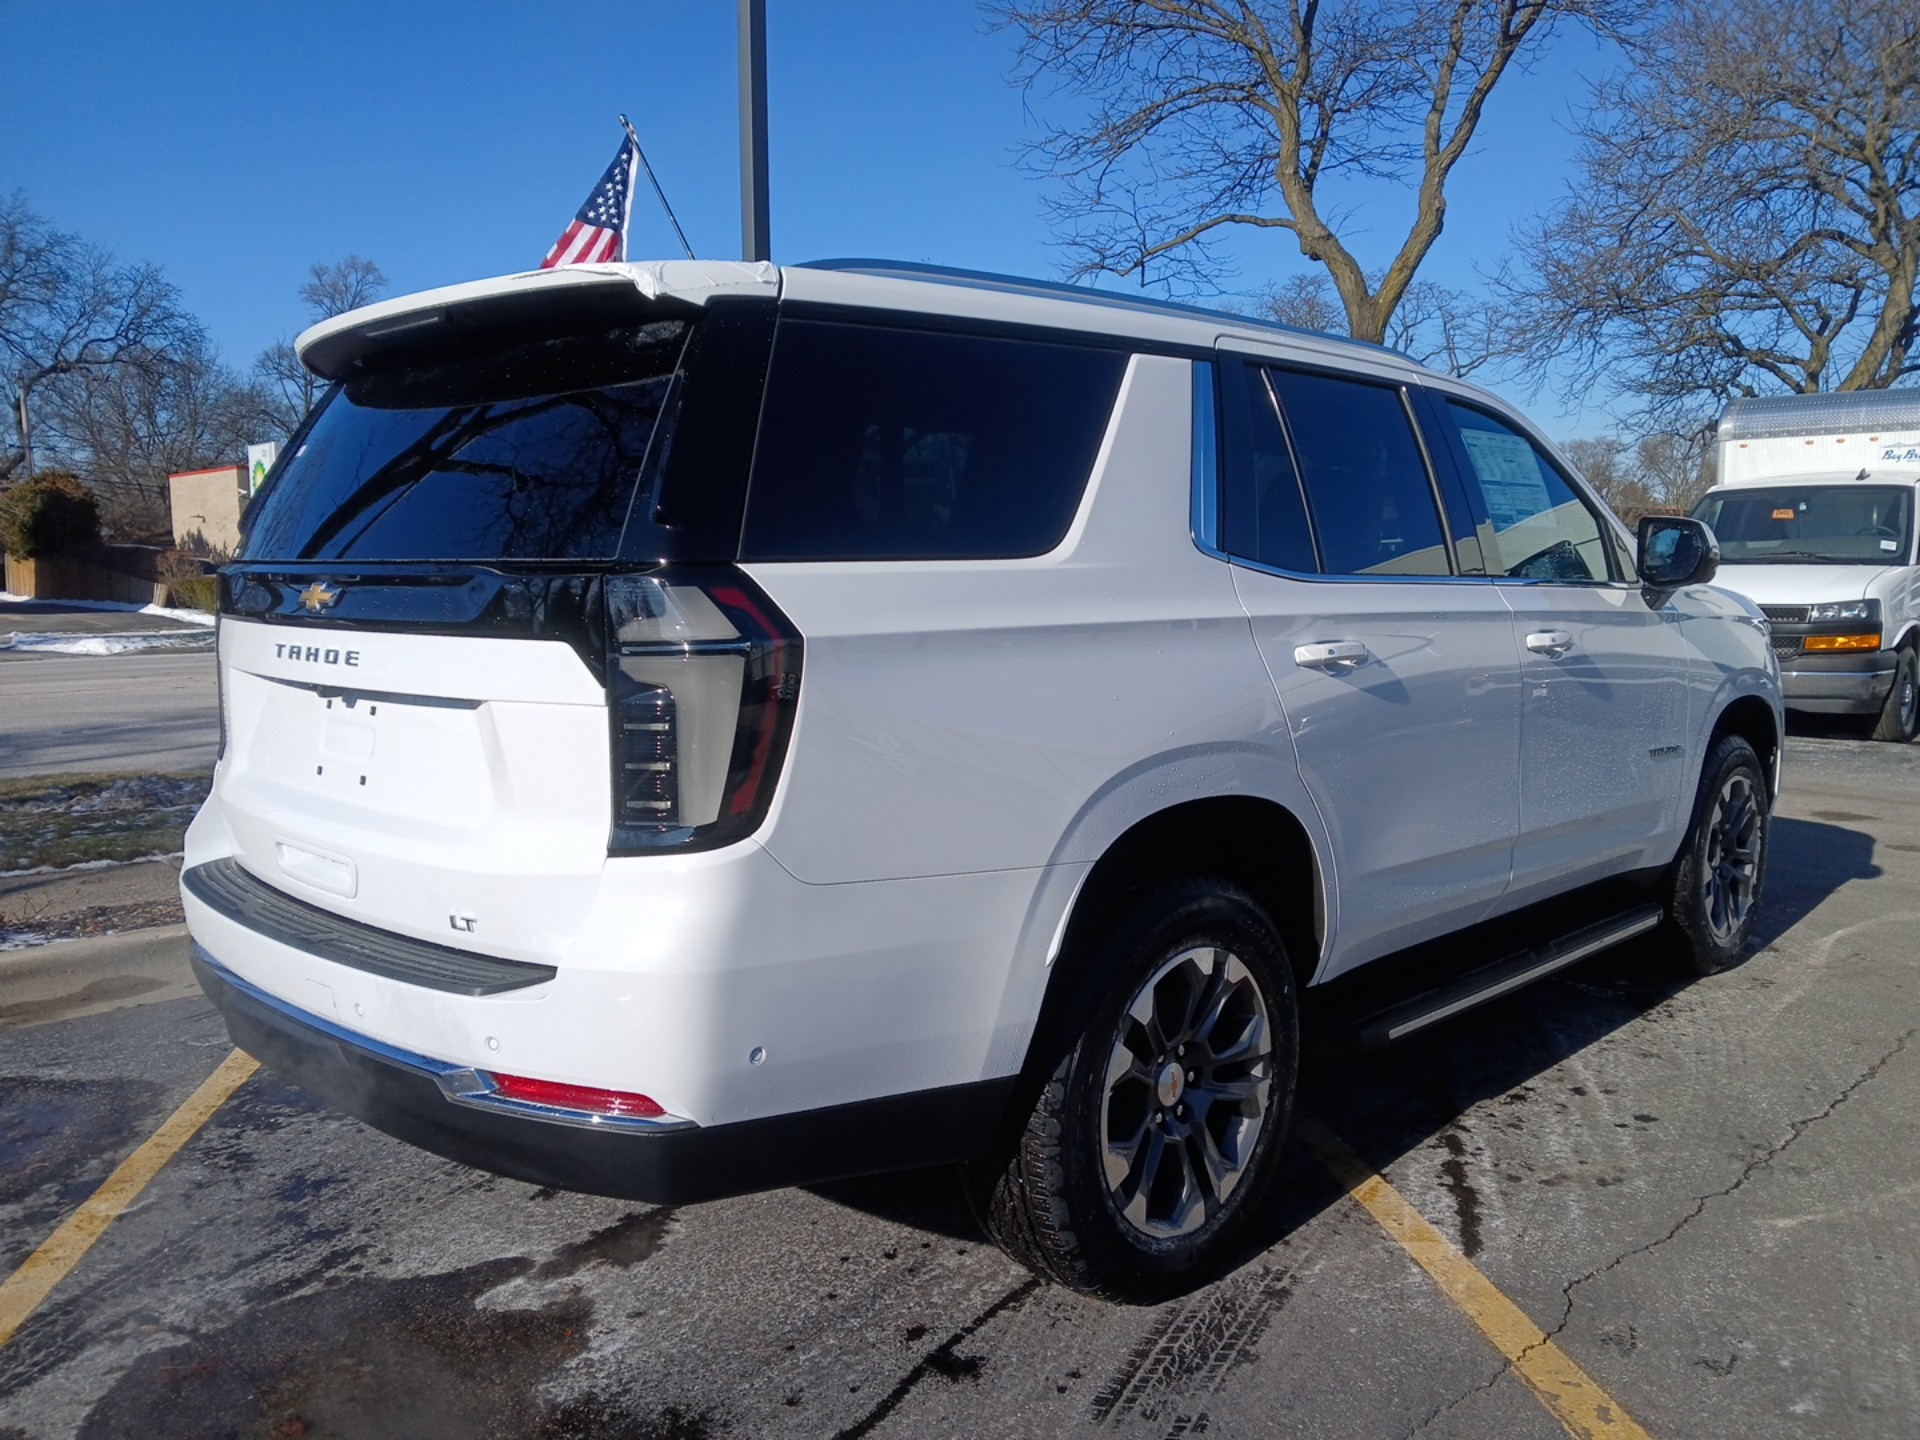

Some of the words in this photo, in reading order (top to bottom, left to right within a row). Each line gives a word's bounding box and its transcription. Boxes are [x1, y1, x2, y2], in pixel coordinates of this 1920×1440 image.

[1881, 449, 1902, 463] Bay
[1903, 449, 1920, 460] Br
[275, 643, 360, 667] TAHOE
[449, 915, 478, 933] LT
